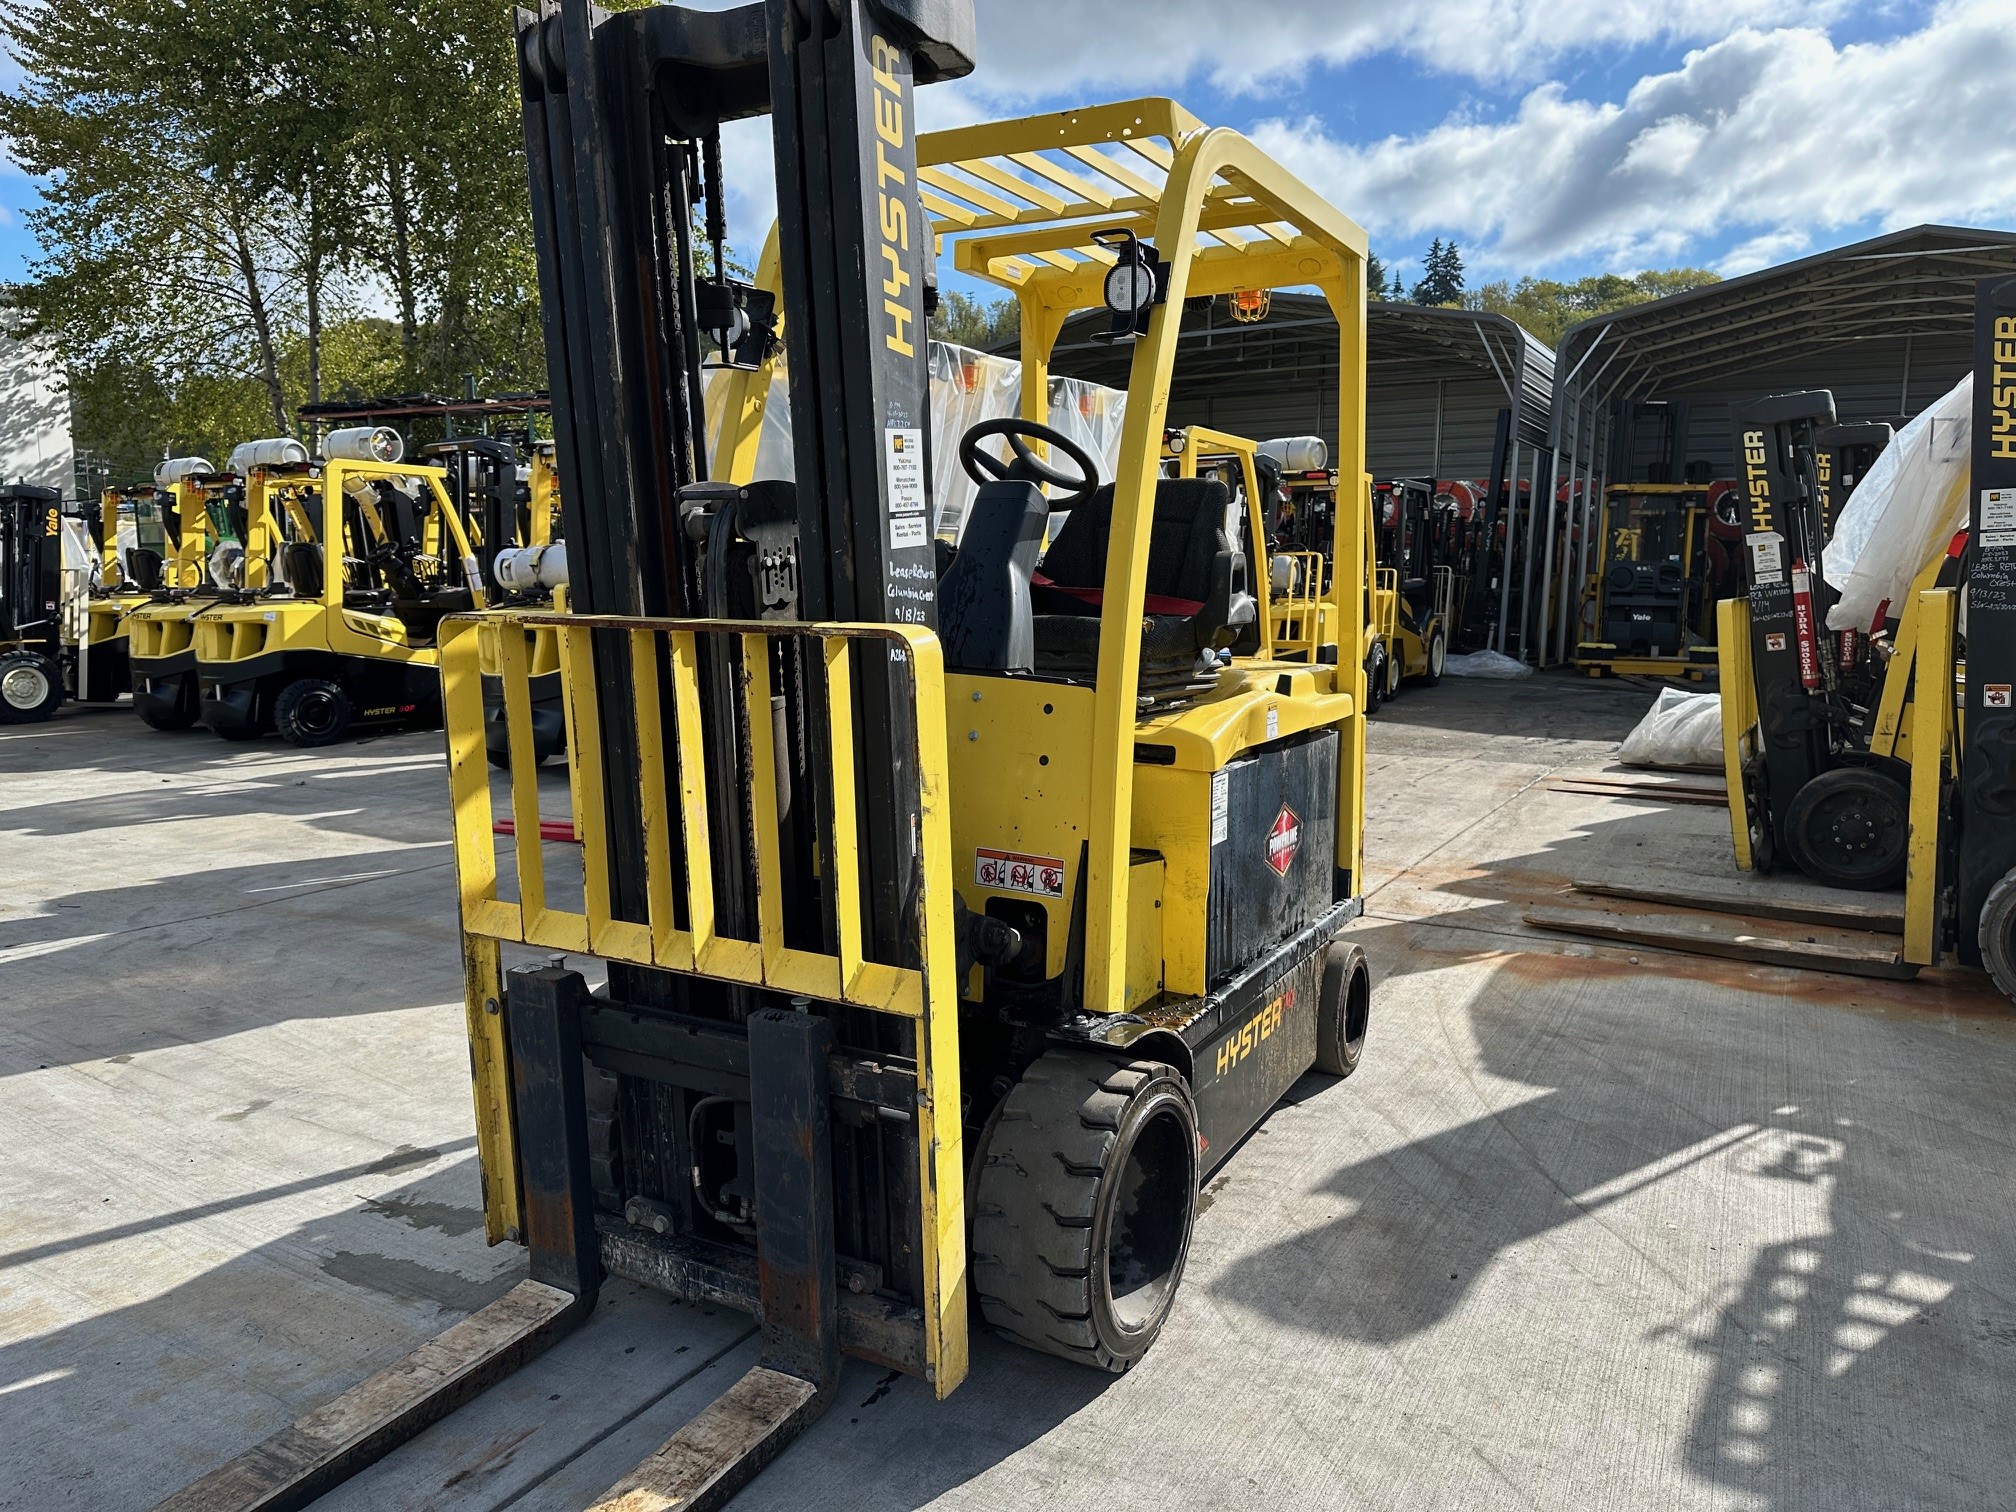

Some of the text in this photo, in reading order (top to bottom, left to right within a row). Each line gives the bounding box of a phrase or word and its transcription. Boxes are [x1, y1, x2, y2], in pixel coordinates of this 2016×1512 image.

[872, 34, 914, 358] HYSTER
[1743, 431, 1774, 532] HYSTER
[46, 508, 58, 537] Yale
[1971, 563, 1995, 571] LEASE
[1971, 571, 2009, 580] Columbia
[887, 583, 919, 600] Columbia
[1970, 587, 2006, 601] 9/13/23
[895, 606, 925, 623] 9/13/23
[1633, 613, 1651, 621] Yale
[1797, 605, 1809, 635] HYDRA
[1800, 640, 1811, 675] SMOOTH
[1844, 632, 1853, 661] SMOOTH
[364, 706, 396, 717] HYSTER
[1216, 996, 1283, 1076] HYSTER
